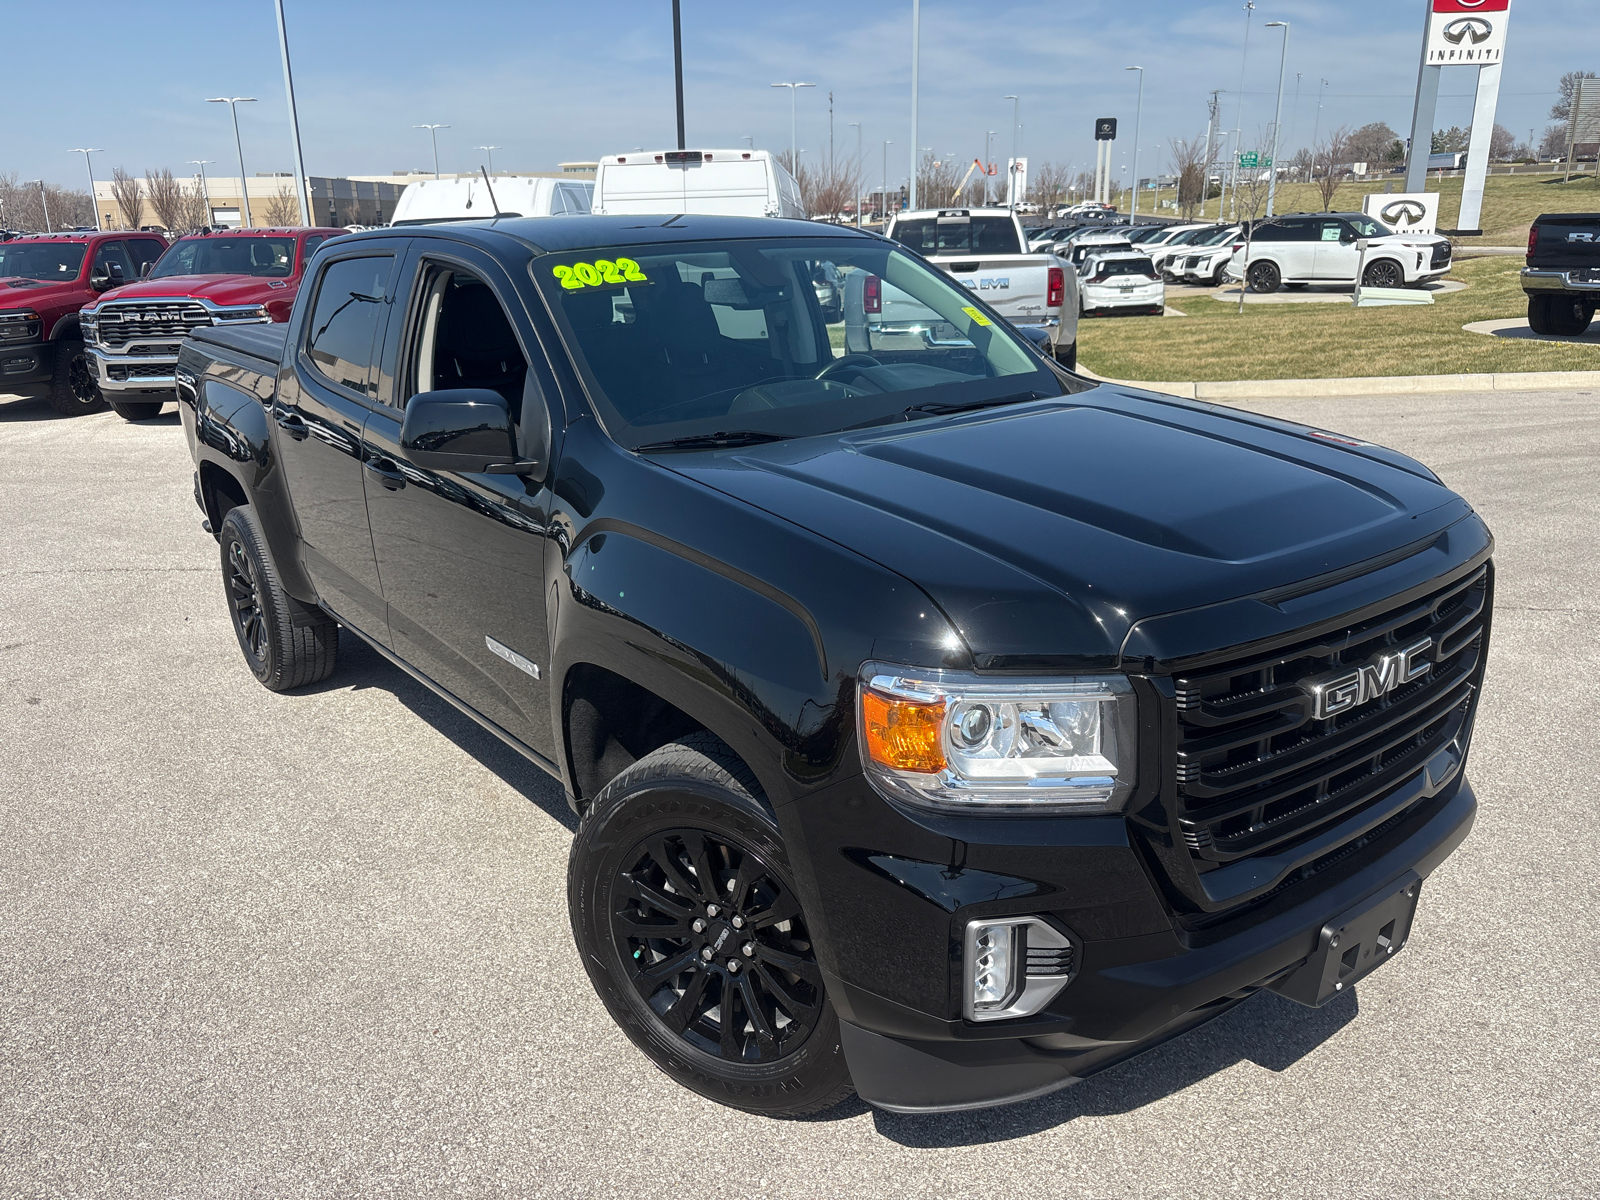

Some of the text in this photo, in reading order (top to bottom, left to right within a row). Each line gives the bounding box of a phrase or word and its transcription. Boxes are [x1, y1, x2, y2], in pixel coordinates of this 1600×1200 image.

[1430, 49, 1499, 60] INFINITI
[553, 258, 648, 290] 2022
[960, 278, 1009, 290] AM
[123, 311, 180, 322] RAM
[1313, 636, 1432, 720] GMC
